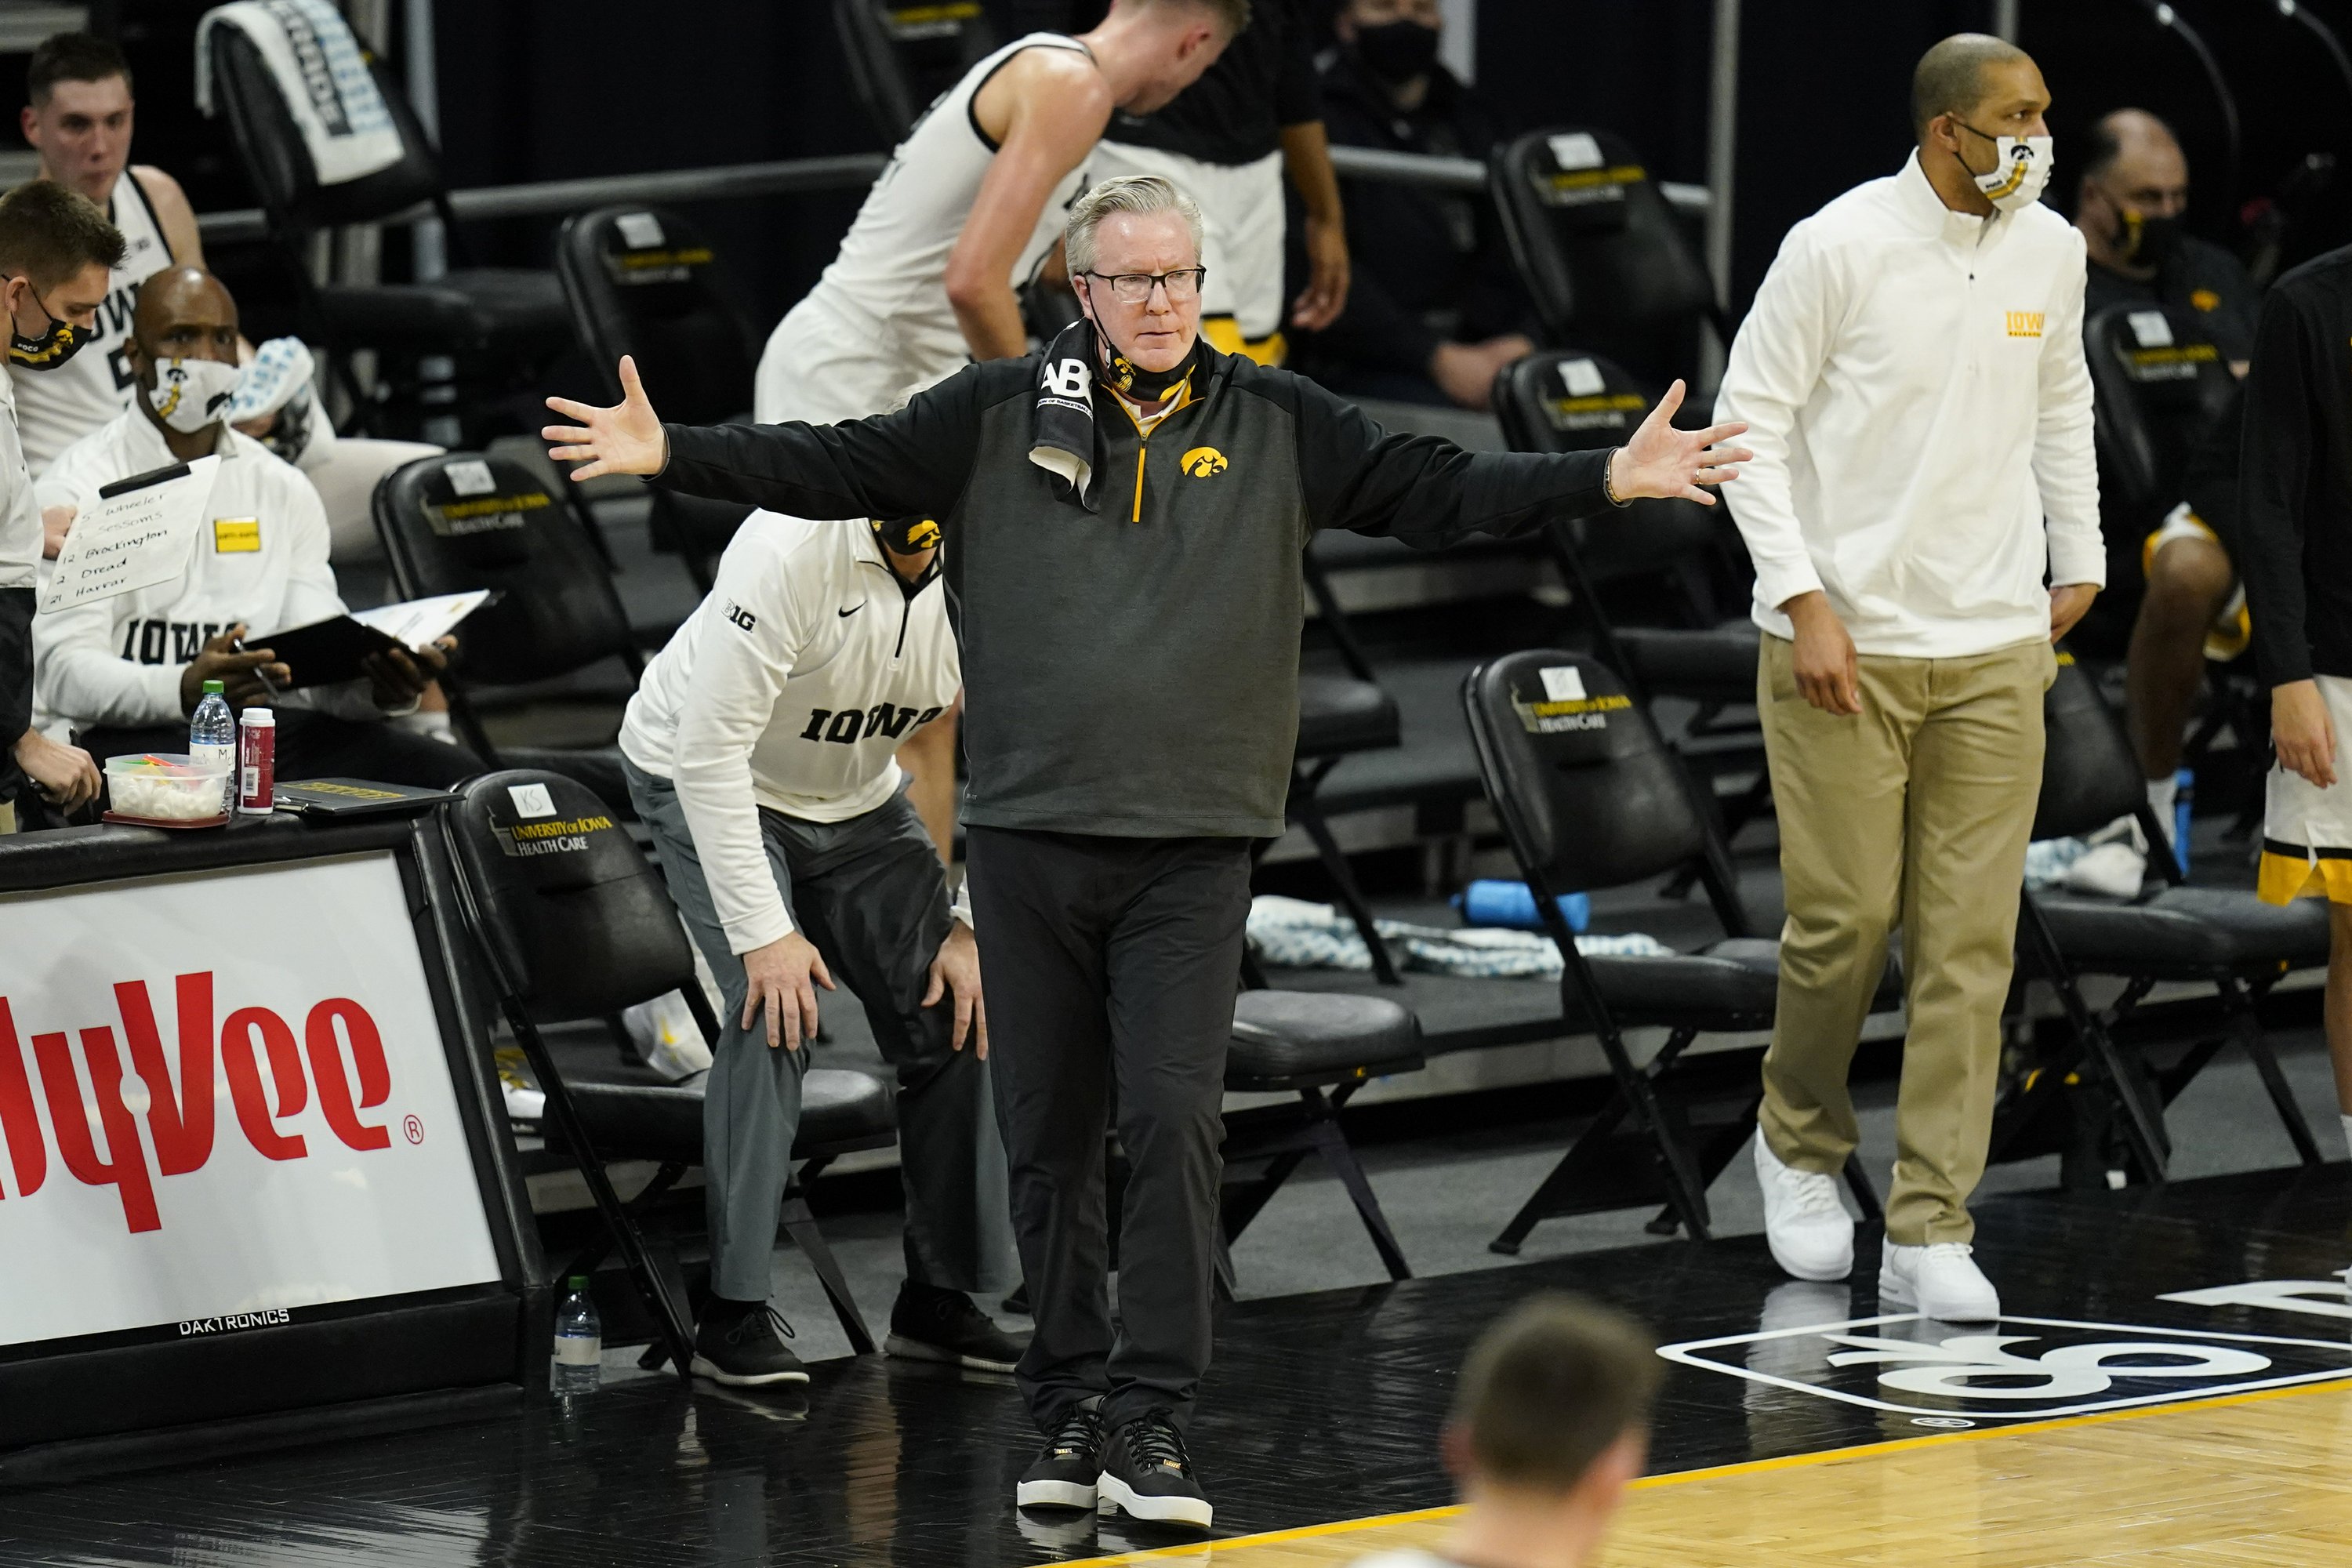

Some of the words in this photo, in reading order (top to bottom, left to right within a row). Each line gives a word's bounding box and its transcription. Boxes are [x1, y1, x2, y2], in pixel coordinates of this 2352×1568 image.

[63, 554, 74, 564] 12
[85, 529, 168, 560] Brockington
[56, 575, 65, 585] 2
[82, 557, 127, 579] Dread
[49, 594, 62, 604] 21
[76, 576, 127, 597] Harrar
[122, 619, 243, 666] IOW
[521, 789, 543, 812] KS
[511, 821, 568, 841] UNIVERSITY
[577, 816, 613, 833] IOWA
[517, 839, 559, 857] HEALTH
[557, 837, 589, 852] CARE
[179, 1308, 290, 1336] DAKTRONICS
